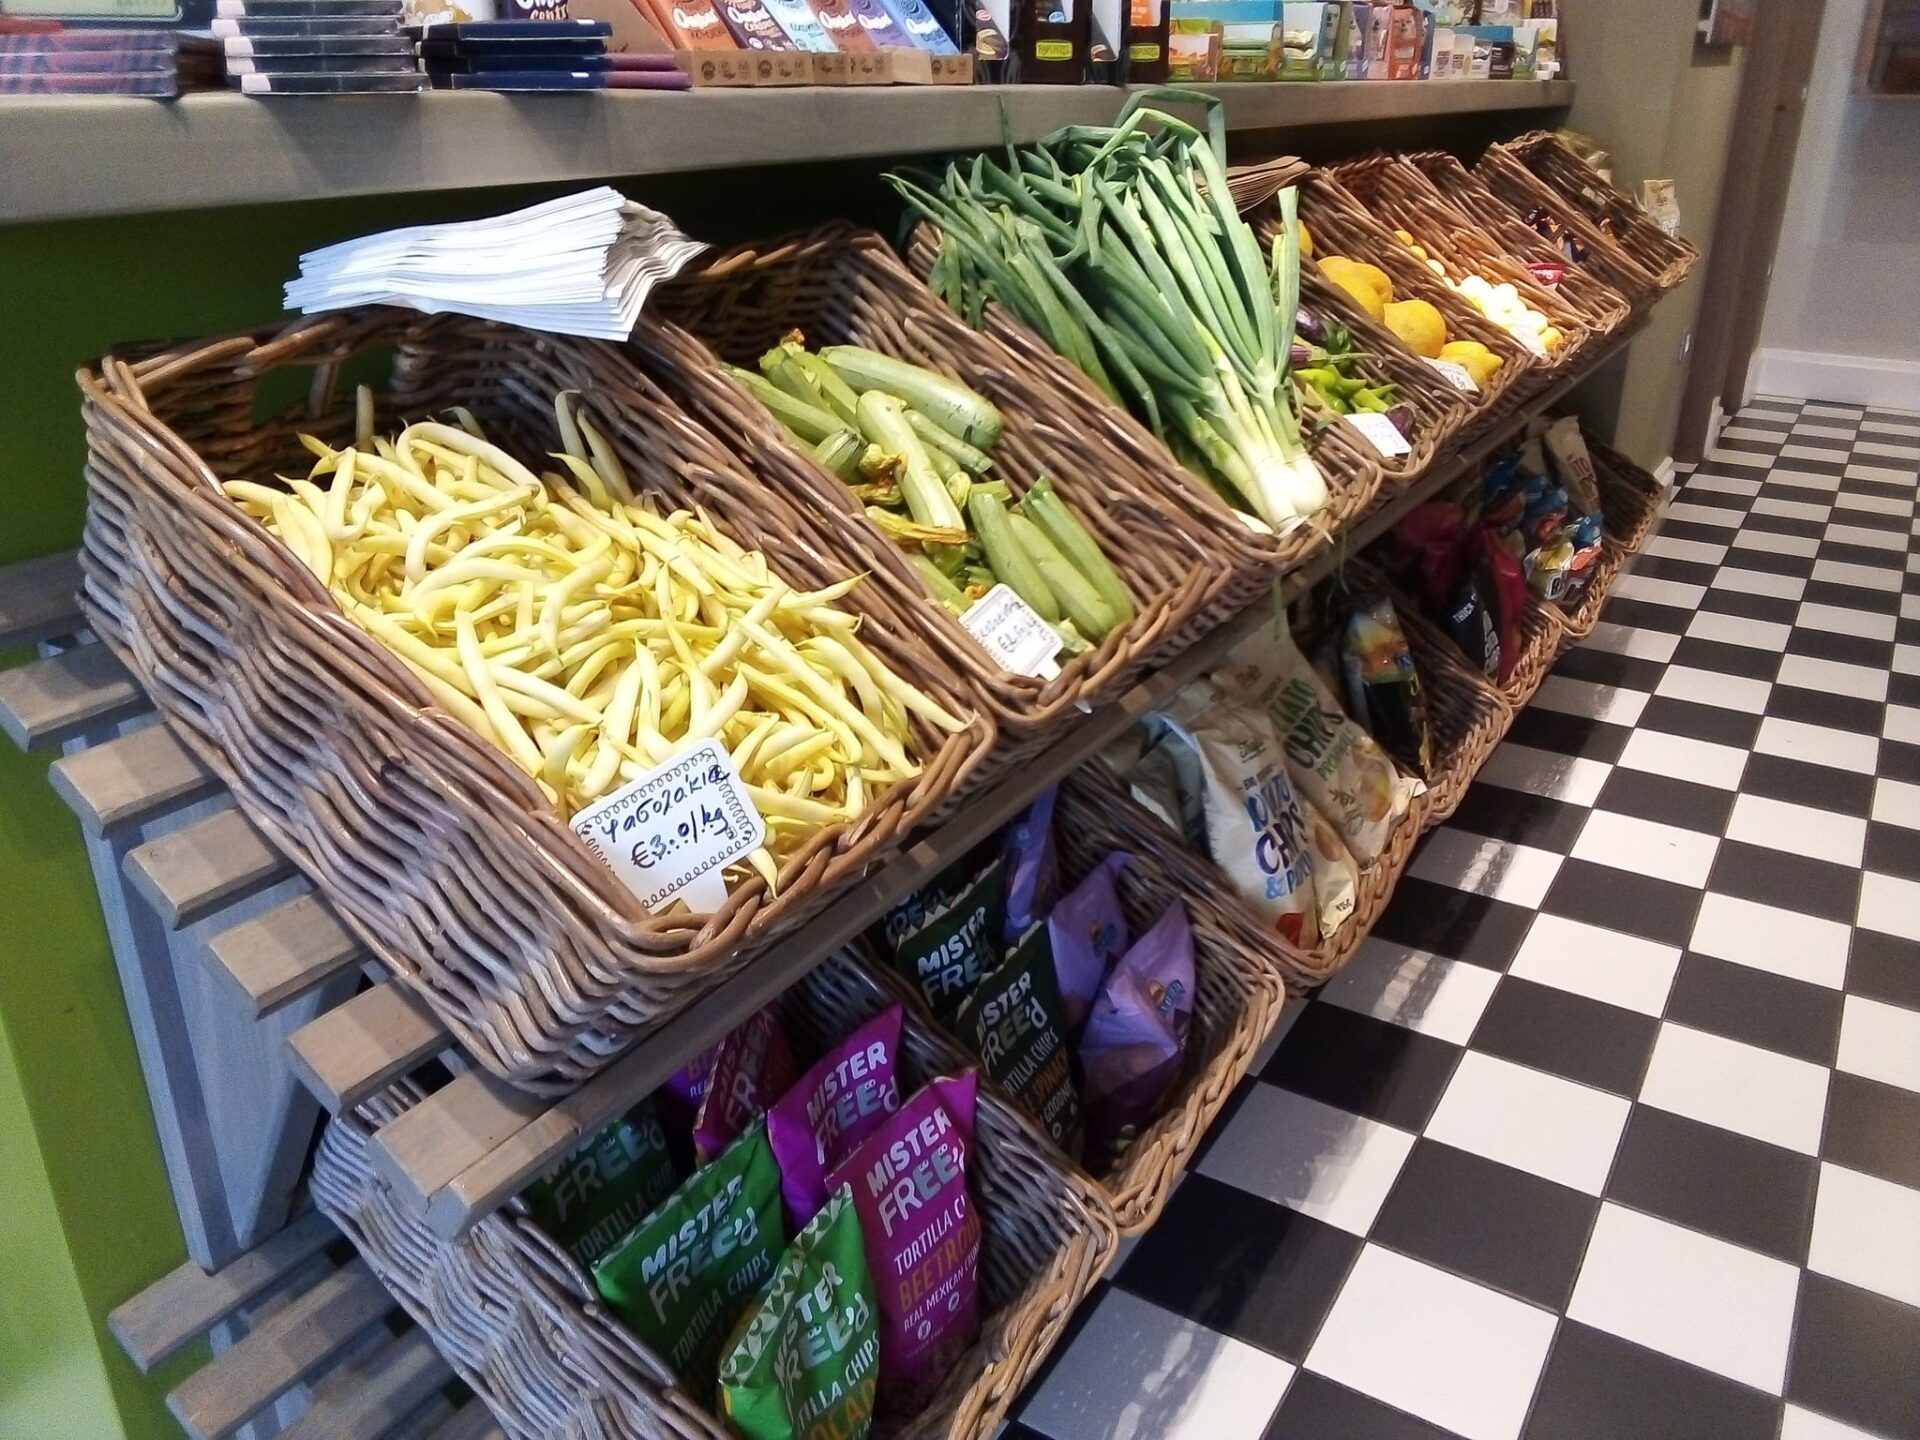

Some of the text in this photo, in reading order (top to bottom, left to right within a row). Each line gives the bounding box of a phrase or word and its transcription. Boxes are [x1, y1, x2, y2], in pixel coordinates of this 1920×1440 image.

[917, 906, 985, 976] MISTER
[981, 995, 1049, 1079] FREE'd
[1030, 1026, 1059, 1063] CHIPS
[806, 1041, 888, 1129] MISTER
[814, 1074, 901, 1166] FREE'd
[866, 1105, 953, 1198] MISTER
[641, 1174, 743, 1284] MISTER
[648, 1206, 759, 1325] FREE'd
[893, 1210, 953, 1276] TORTILLA
[671, 1248, 771, 1369] TORTILLA CHIPS
[903, 1305, 924, 1334] REAL
[926, 1267, 966, 1312] MEXICAN
[845, 1330, 880, 1387] CHIPS
